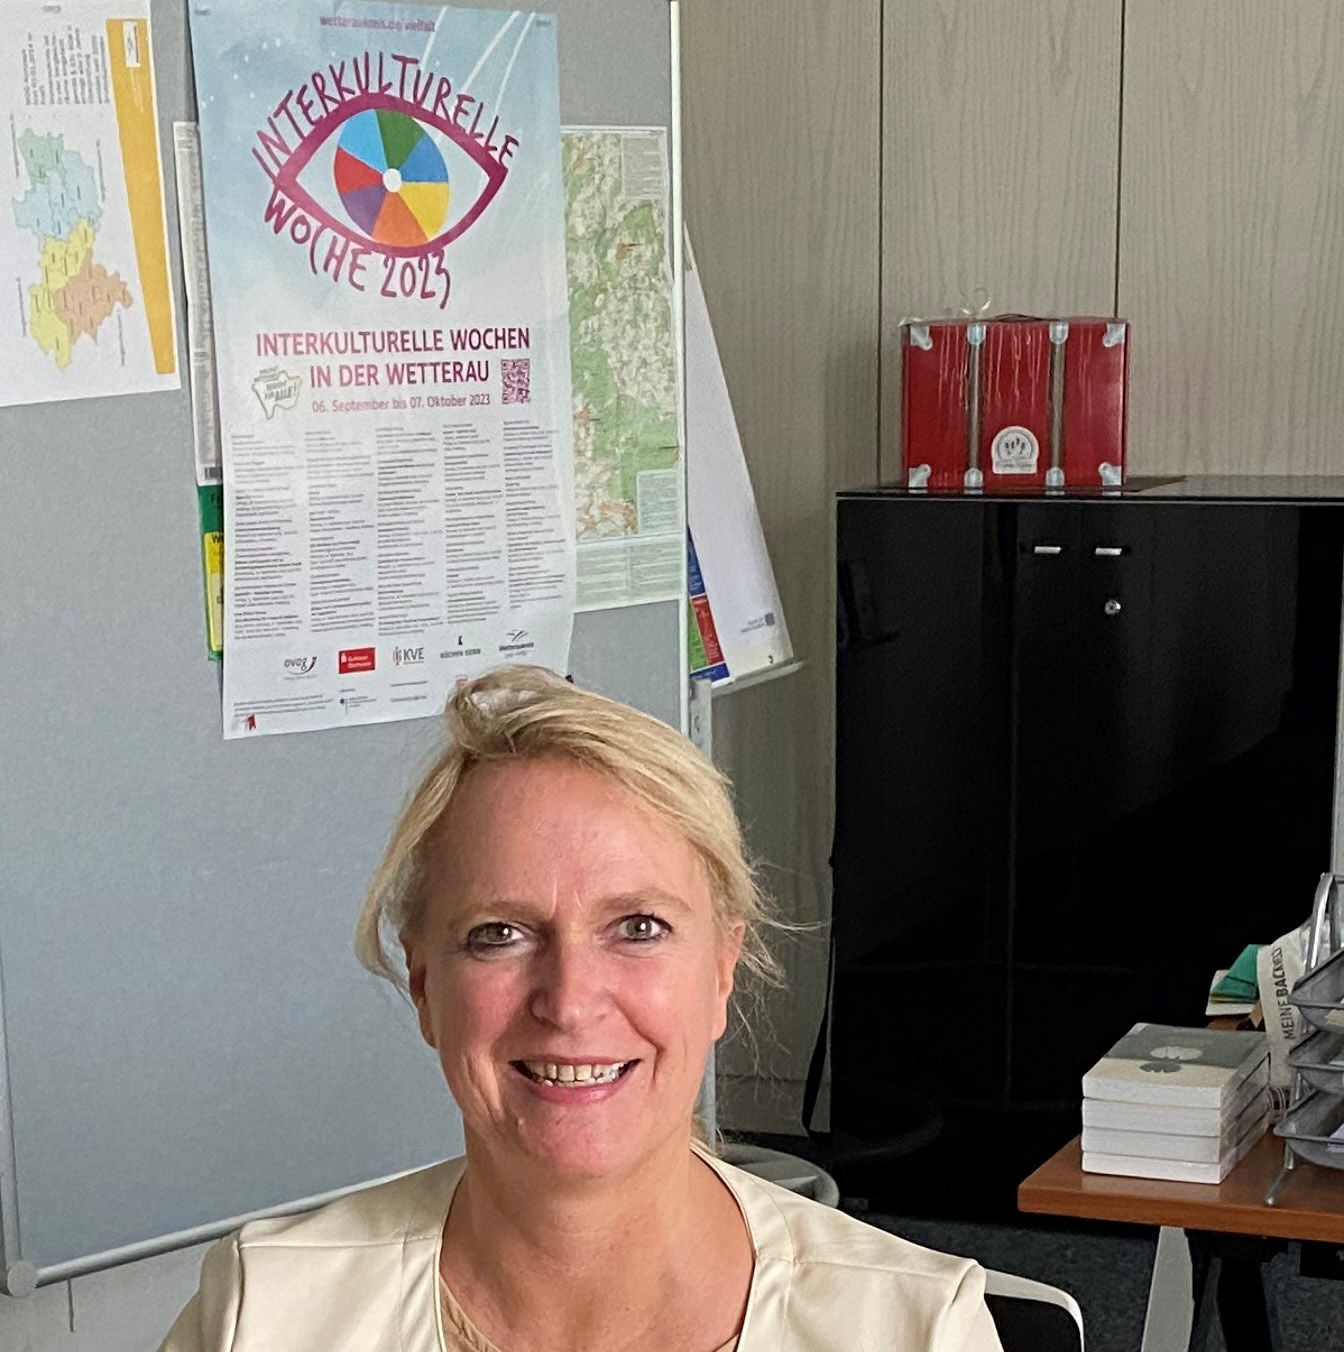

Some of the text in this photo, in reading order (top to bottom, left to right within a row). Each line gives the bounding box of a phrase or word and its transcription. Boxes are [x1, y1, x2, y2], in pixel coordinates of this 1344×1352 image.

[252, 51, 520, 181] INTERKULTURELLE
[264, 185, 451, 309] WOCHE 2023
[256, 327, 531, 357] INTERKULTURELLE WOCHEN
[309, 365, 333, 388] IN
[339, 363, 380, 387] DER
[386, 360, 490, 385] WETTERAU
[311, 393, 491, 415] 06. September bis 07. Oktober 2023
[403, 647, 425, 661] KVE
[1278, 1000, 1296, 1040] MEINE
